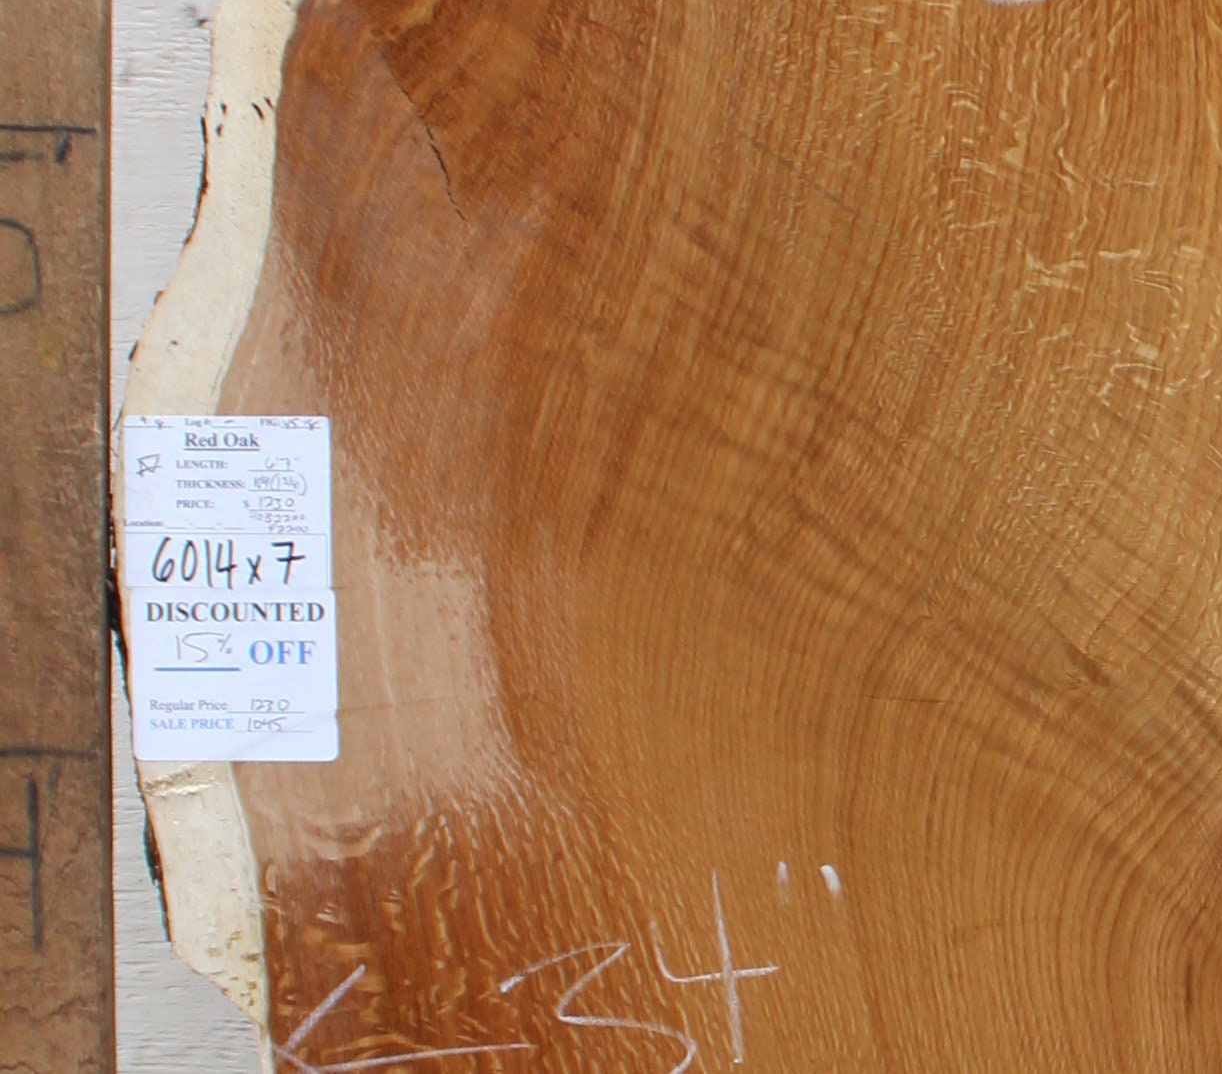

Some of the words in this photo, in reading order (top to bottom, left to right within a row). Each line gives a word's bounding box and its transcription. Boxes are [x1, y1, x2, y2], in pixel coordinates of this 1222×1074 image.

[184, 432, 217, 447] Red
[223, 432, 260, 447] Oak
[175, 459, 228, 469] LENGTH:
[176, 479, 246, 489] THICKNESS:
[176, 499, 214, 509] PRICE:
[152, 537, 238, 589] 6014
[146, 601, 325, 623] DISCOUNTED
[175, 632, 233, 663] 15%
[249, 639, 316, 666] OFF
[149, 699, 195, 715] Regular
[198, 699, 228, 711] Price
[250, 698, 290, 712] 1230
[149, 718, 186, 730] SALE
[191, 718, 234, 730] PRICE
